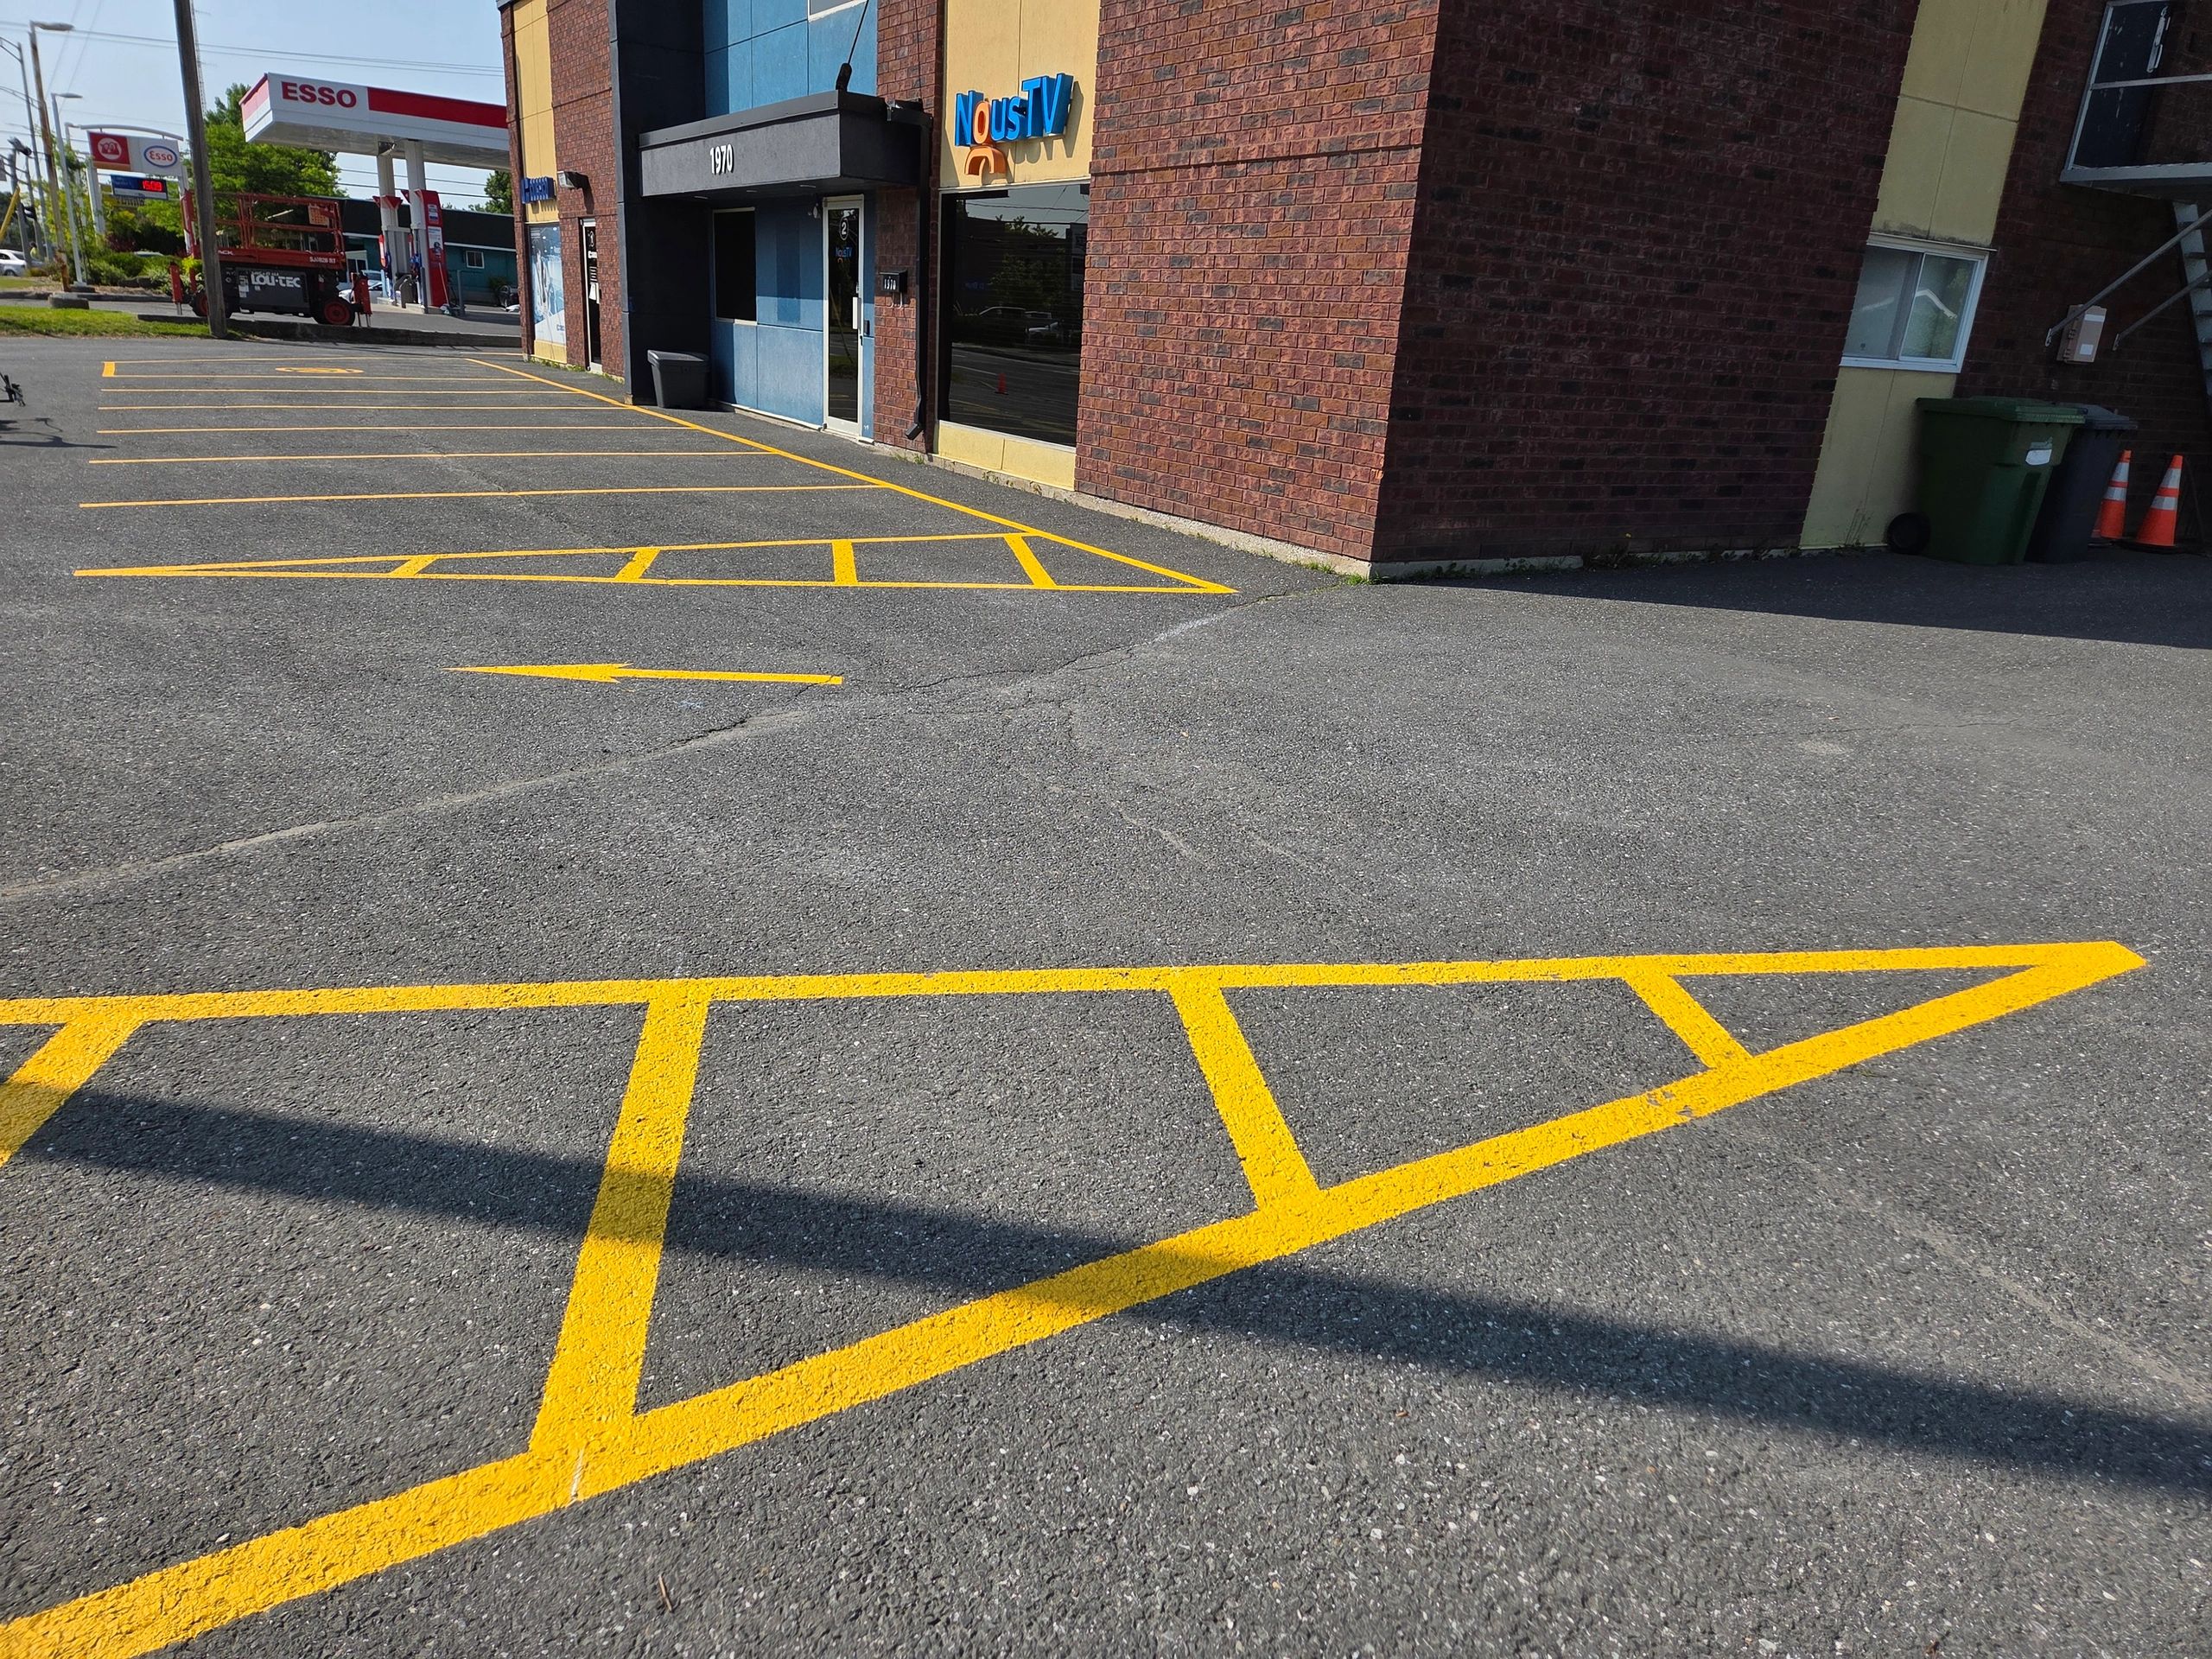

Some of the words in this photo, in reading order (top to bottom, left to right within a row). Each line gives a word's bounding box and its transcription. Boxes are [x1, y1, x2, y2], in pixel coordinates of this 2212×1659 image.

[281, 81, 357, 108] ESSO
[709, 143, 734, 175] 1970
[841, 221, 847, 235] 2
